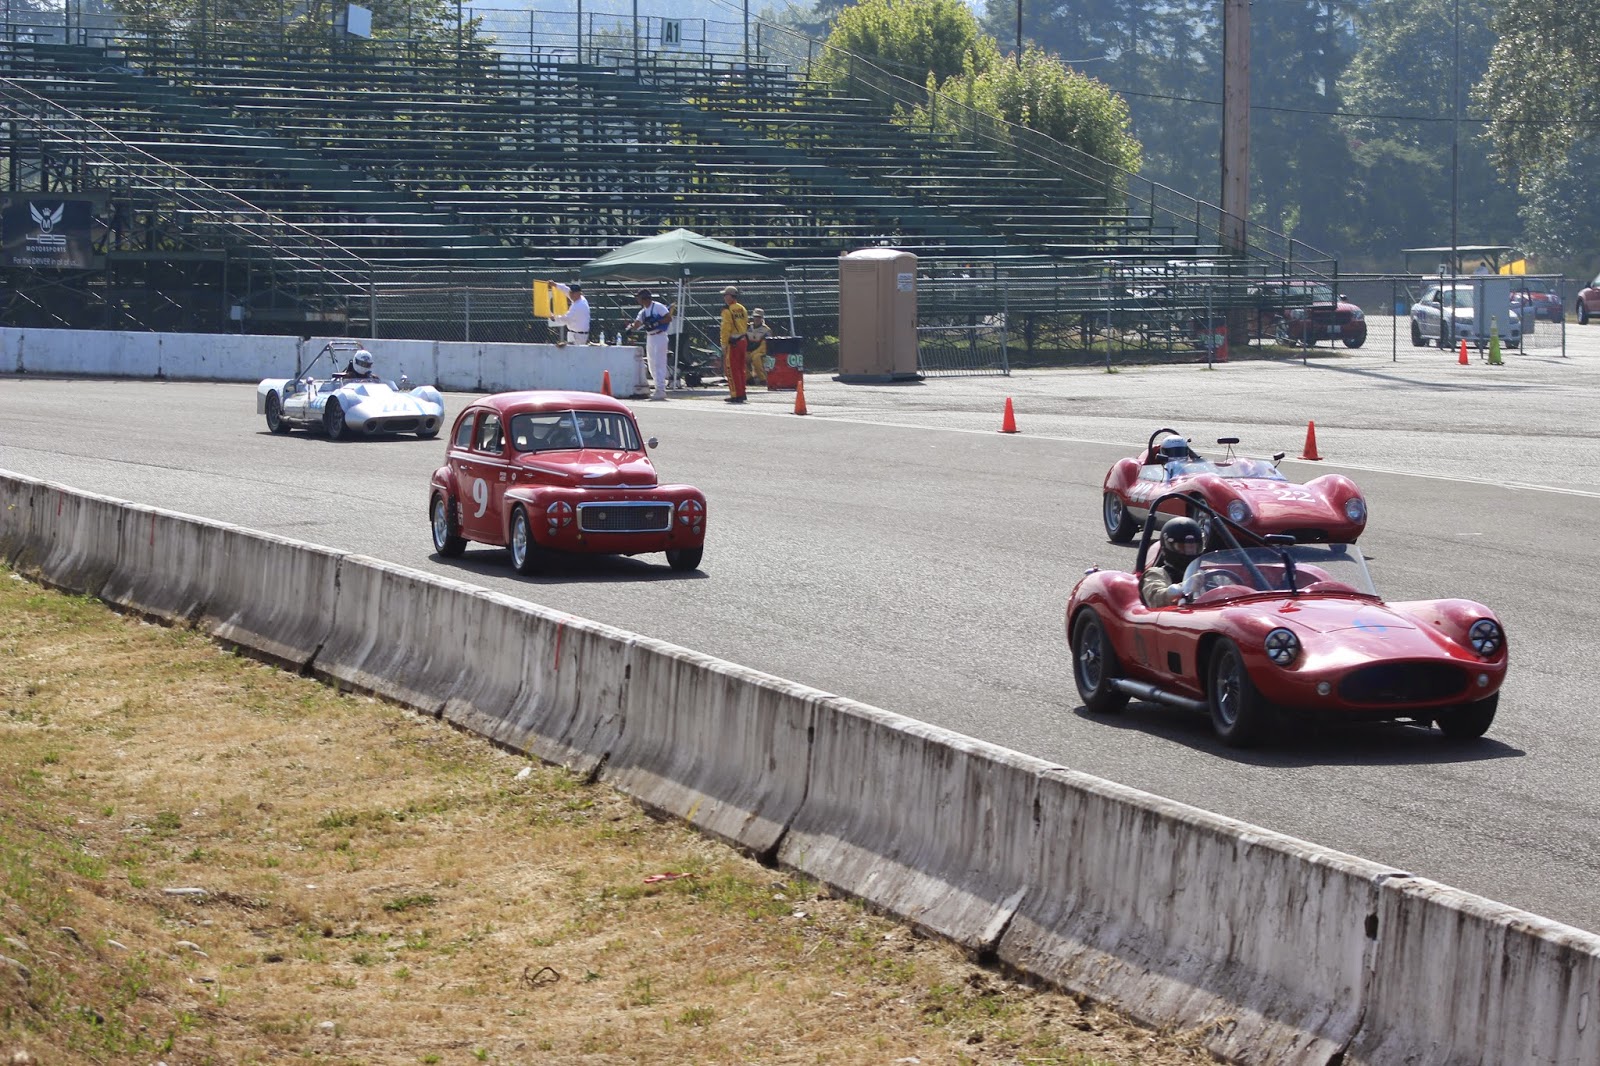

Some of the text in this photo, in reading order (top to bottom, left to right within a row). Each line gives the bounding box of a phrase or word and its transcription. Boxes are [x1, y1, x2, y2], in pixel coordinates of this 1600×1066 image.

[665, 21, 679, 43] A1
[473, 477, 488, 518] 9
[1130, 482, 1154, 503] 22
[1273, 489, 1316, 503] 22
